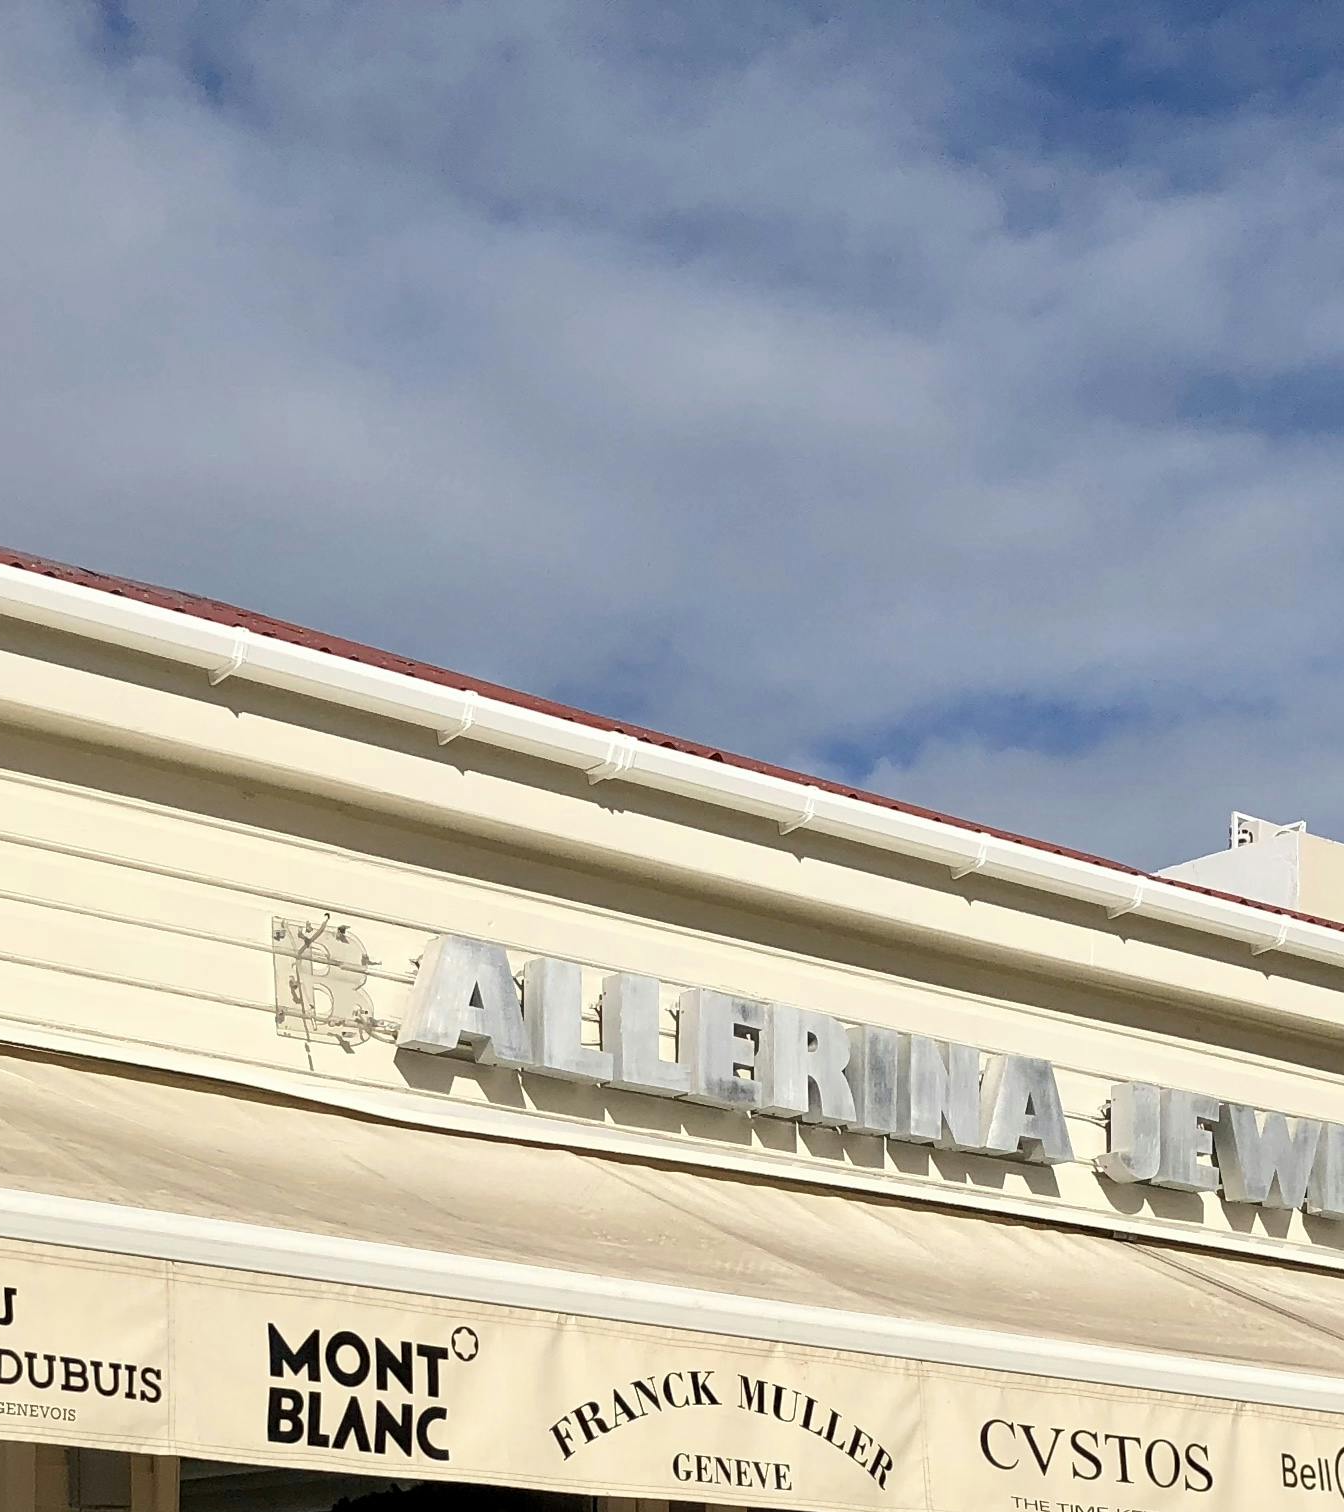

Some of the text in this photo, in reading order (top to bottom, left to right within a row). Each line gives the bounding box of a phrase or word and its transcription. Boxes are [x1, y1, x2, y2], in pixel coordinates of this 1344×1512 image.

[267, 1322, 449, 1399] MONT
[267, 1387, 451, 1462] BLANC
[549, 1370, 894, 1491] FRANCK MULLER
[979, 1419, 1214, 1493] CVSTOS
[671, 1452, 793, 1492] GENEVE
[1010, 1495, 1050, 1512] THE
